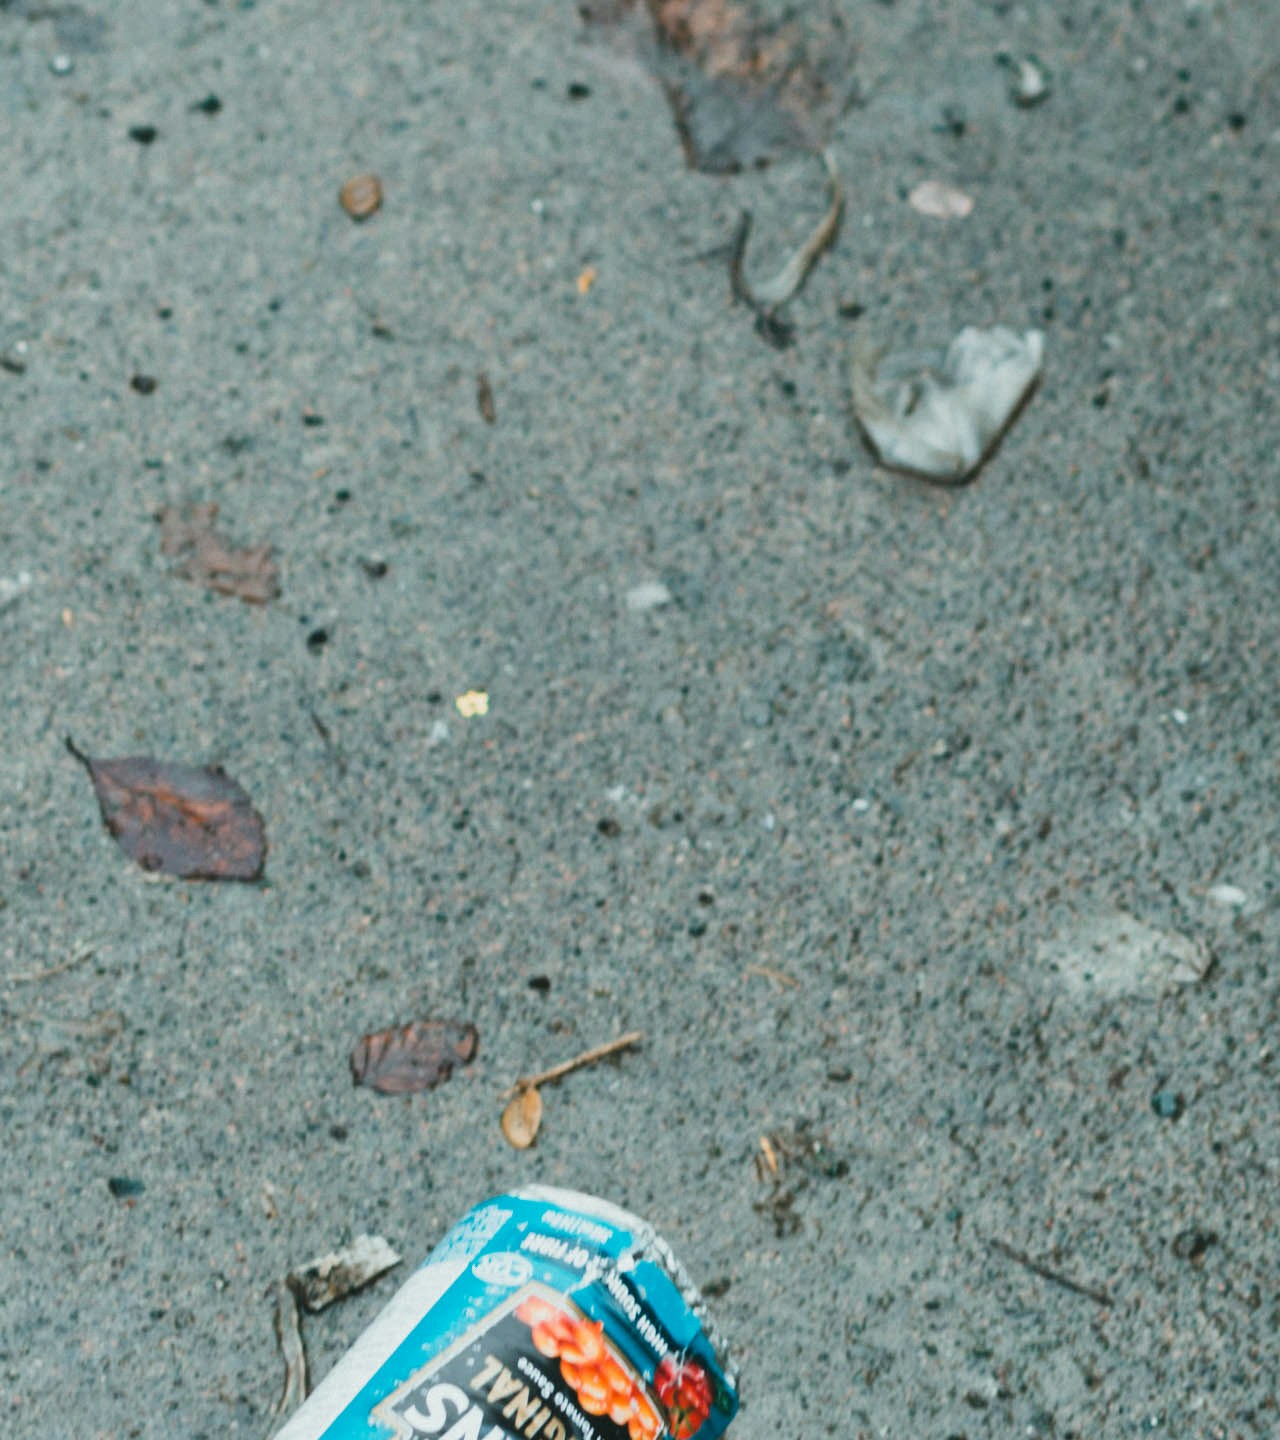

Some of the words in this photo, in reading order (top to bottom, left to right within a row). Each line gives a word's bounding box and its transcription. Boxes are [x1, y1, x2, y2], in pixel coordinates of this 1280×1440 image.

[564, 1246, 590, 1269] OF
[636, 1314, 669, 1356] HIGH
[517, 1356, 555, 1399] Sauce
